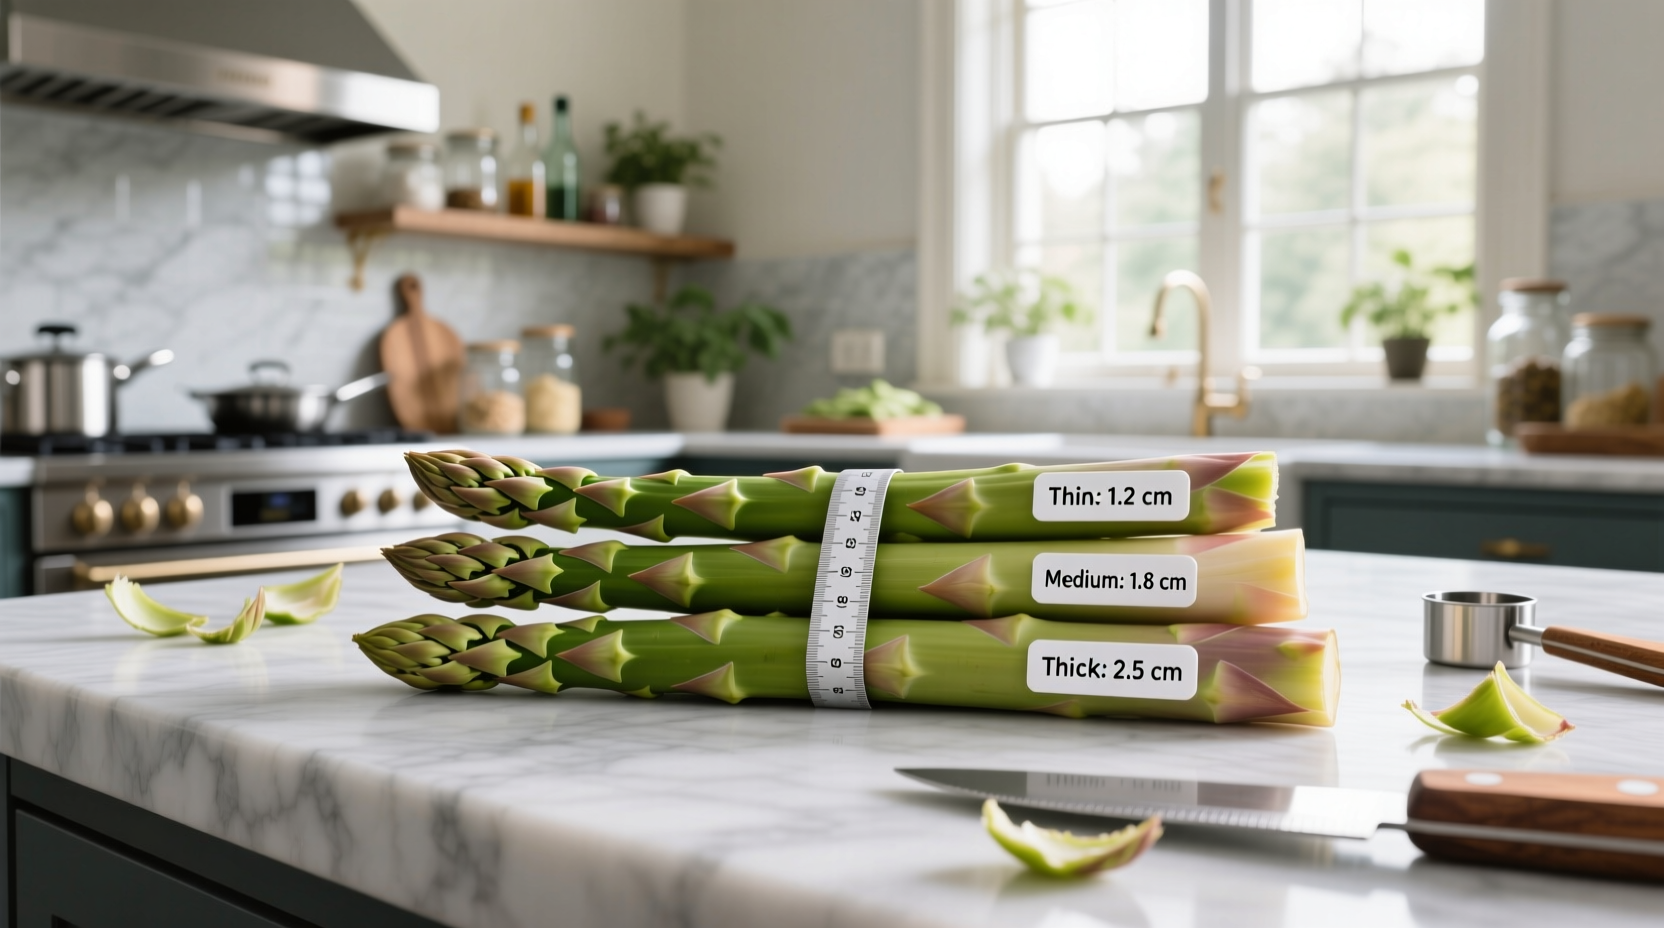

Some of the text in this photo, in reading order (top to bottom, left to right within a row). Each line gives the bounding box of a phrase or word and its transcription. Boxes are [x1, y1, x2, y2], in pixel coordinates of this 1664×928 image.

[1048, 486, 1174, 506] Thin: 1.2 cm
[1045, 568, 1188, 591] Medium: 1.8 cm
[1042, 656, 1183, 682] Thick: 2.5 cm
